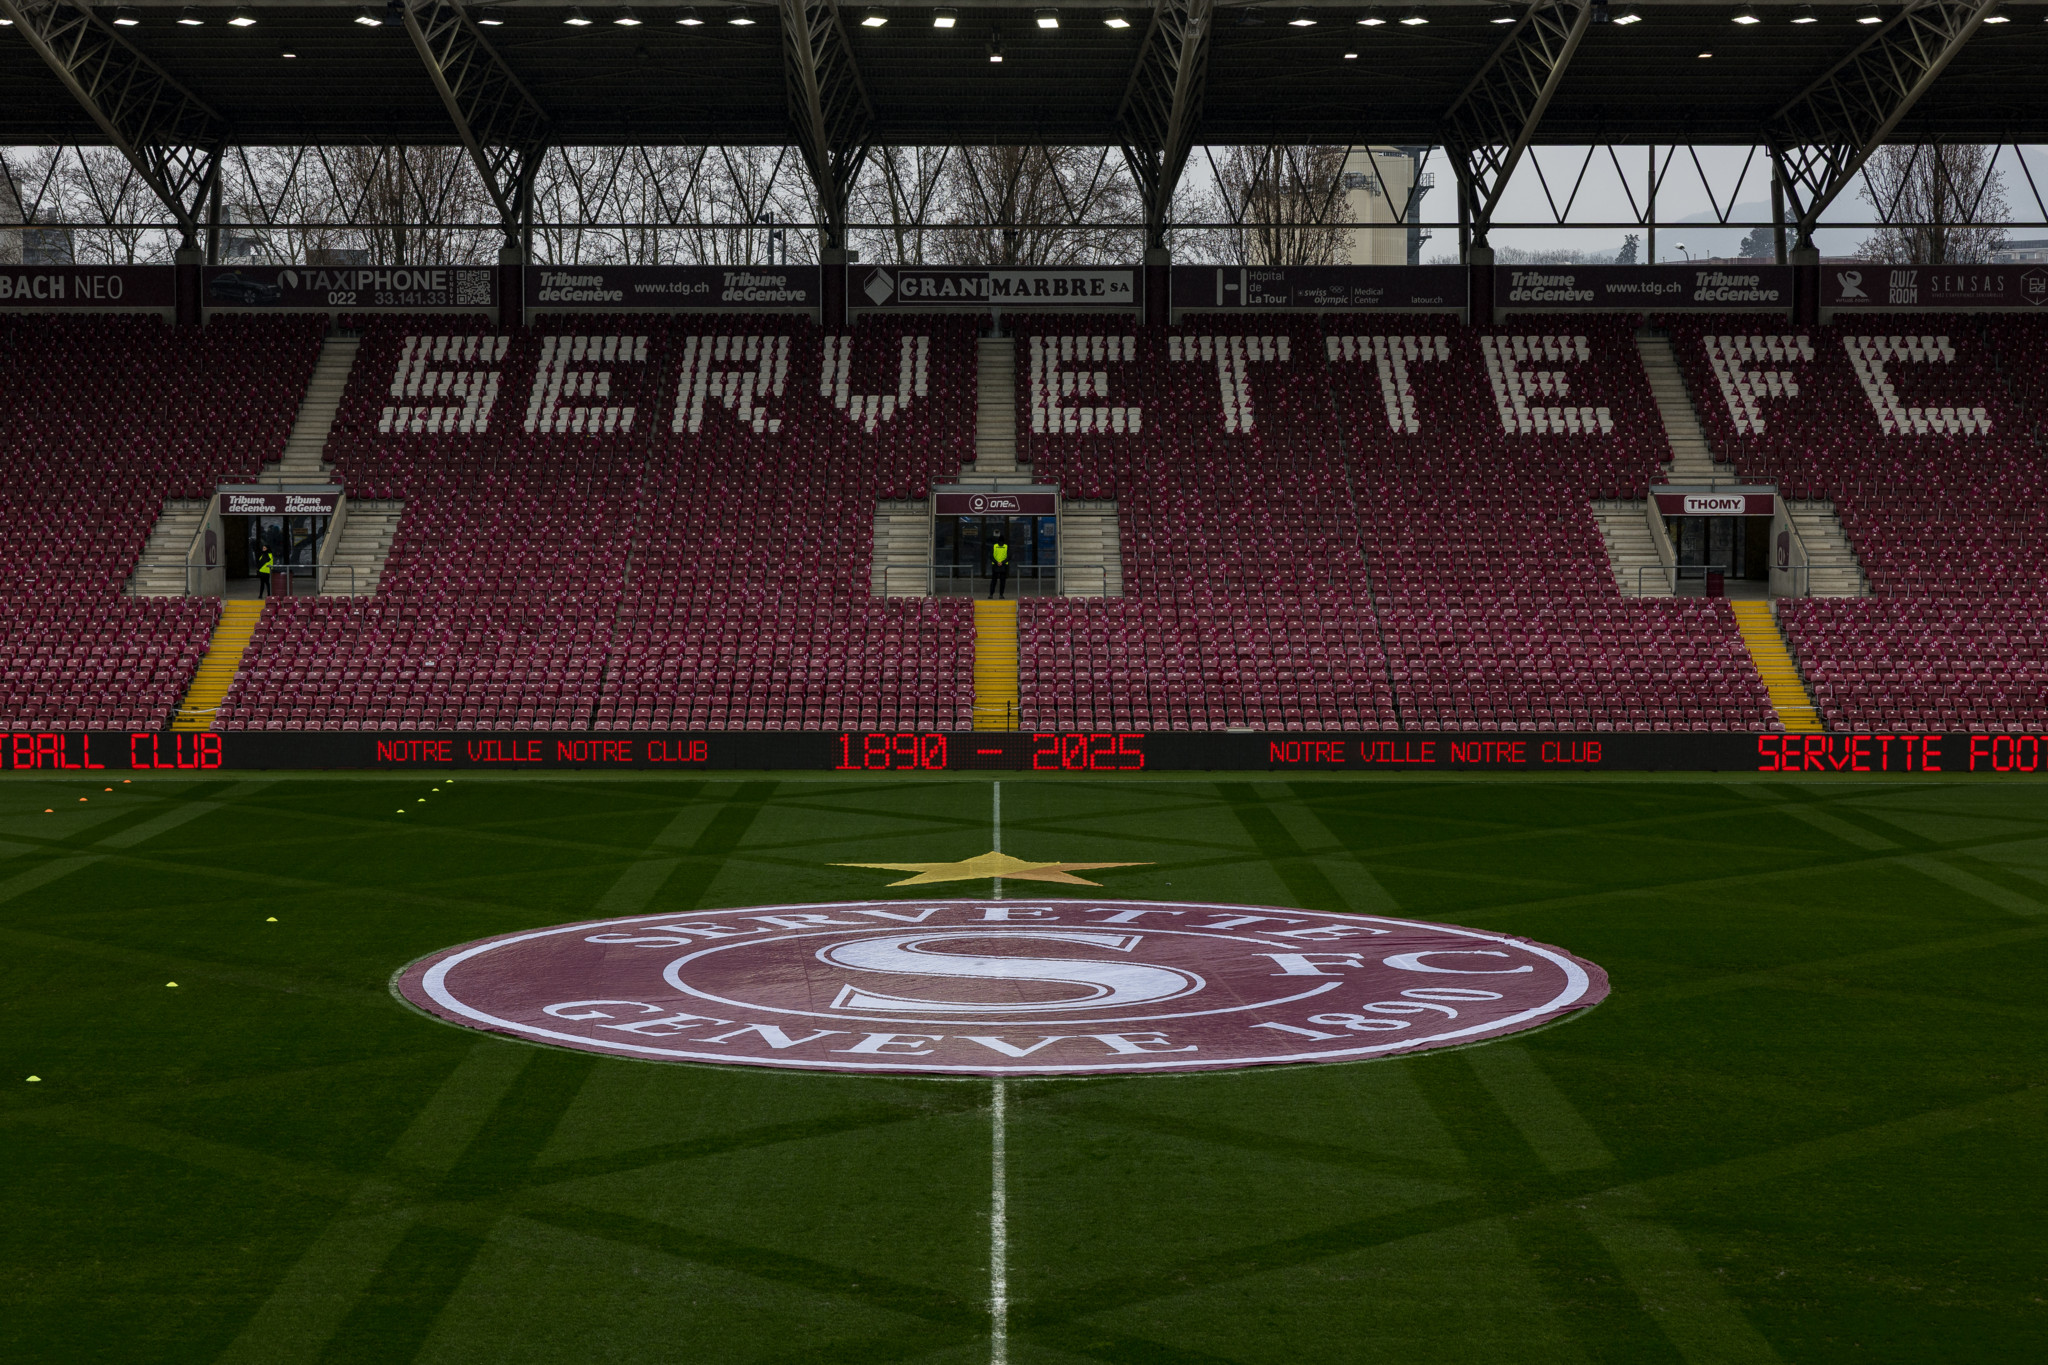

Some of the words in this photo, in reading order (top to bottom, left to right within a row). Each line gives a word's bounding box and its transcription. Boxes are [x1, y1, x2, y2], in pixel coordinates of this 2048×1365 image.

[300, 270, 447, 291] TAXIPHONE
[540, 272, 604, 287] Tribune
[723, 272, 787, 287] Tribune
[1249, 271, 1285, 282] Hôpital
[1511, 272, 1575, 287] Tribune
[1695, 272, 1760, 287] Tribune
[1890, 270, 1918, 288] QUIZ
[1931, 275, 2004, 292] SENSAS
[0, 275, 64, 299] BACH
[75, 275, 123, 299] NEO
[538, 287, 623, 301] deGenève
[634, 282, 710, 296] www.tdg.ch
[721, 287, 806, 301] deGenève
[1110, 283, 1130, 293] SA
[1249, 283, 1262, 292] de
[1304, 288, 1327, 297] swiss
[1354, 288, 1383, 296] Medical
[1509, 287, 1594, 301] deGenève
[1606, 282, 1682, 296] www.tdg.ch
[1694, 287, 1779, 301] deGenève
[328, 291, 357, 305] 022
[374, 291, 447, 305] 33.141.33
[1314, 295, 1348, 305] olympic
[1411, 296, 1443, 304] latour.ch
[1889, 288, 1918, 304] ROOM
[229, 495, 265, 505] Tribune
[285, 495, 321, 505] Tribune
[1688, 499, 1741, 510] THOMY
[131, 733, 222, 769] CLUB
[377, 740, 452, 762] NOTRE
[468, 740, 543, 762] VILLE
[557, 740, 633, 762] NOTRE
[648, 740, 708, 762] CLUB
[835, 733, 947, 770] 1890
[1033, 733, 1145, 770] 2025
[1269, 741, 1346, 763] NOTRE
[1360, 741, 1436, 763] VILLE
[1450, 741, 1526, 763] NOTRE
[1541, 741, 1602, 763] CLUB
[1758, 735, 1943, 772] SERVETTE
[584, 906, 1392, 948] SERVETTE
[1252, 951, 1534, 976] FC
[1250, 987, 1504, 1042] 1890
